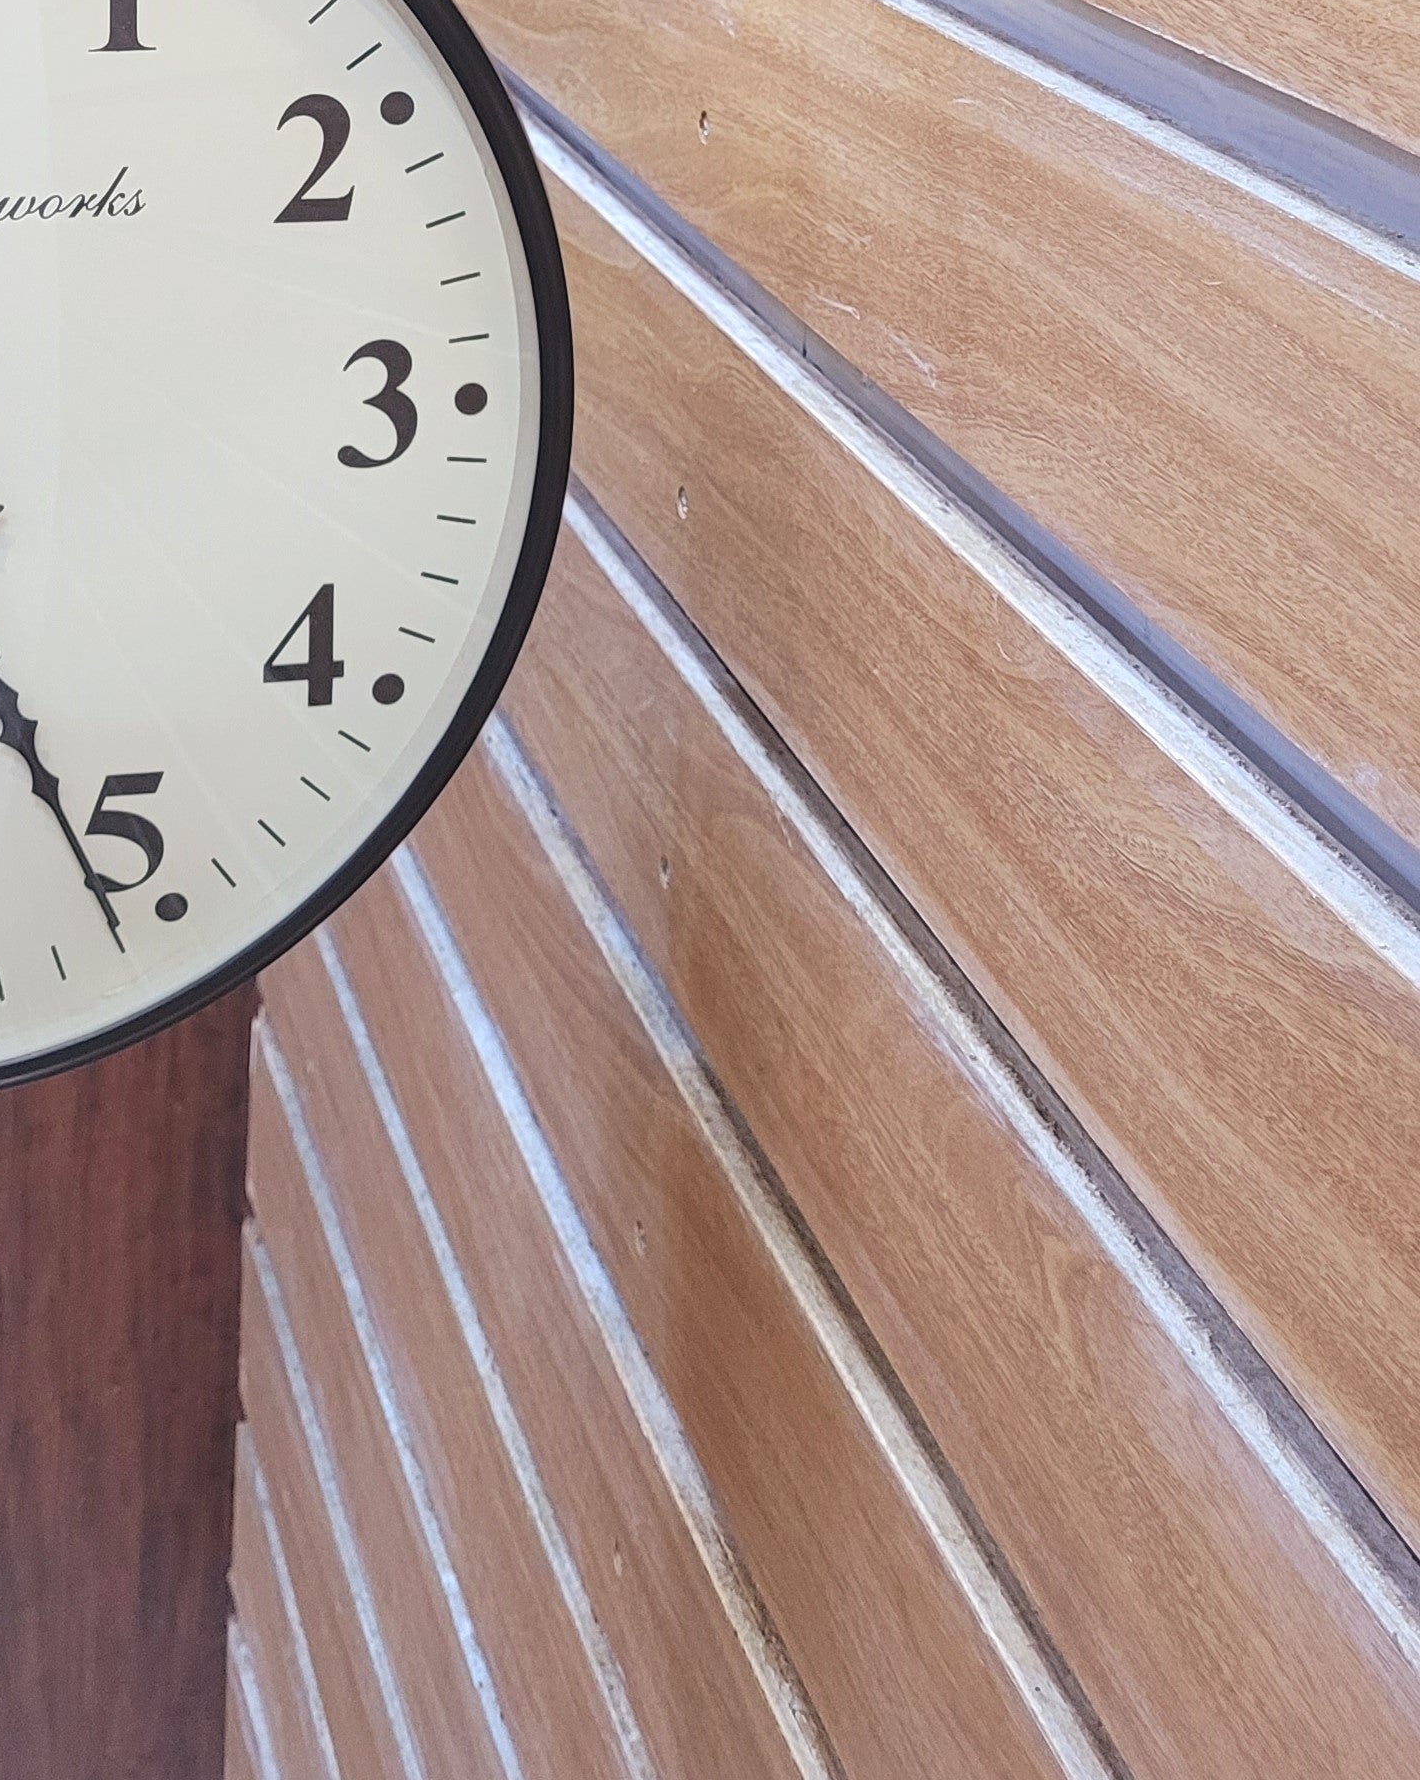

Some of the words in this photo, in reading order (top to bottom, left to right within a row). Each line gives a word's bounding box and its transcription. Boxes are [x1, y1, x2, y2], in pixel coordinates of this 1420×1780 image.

[272, 93, 356, 224] 2
[336, 338, 419, 469] 3
[261, 582, 346, 708] 4
[83, 770, 165, 893] 5
